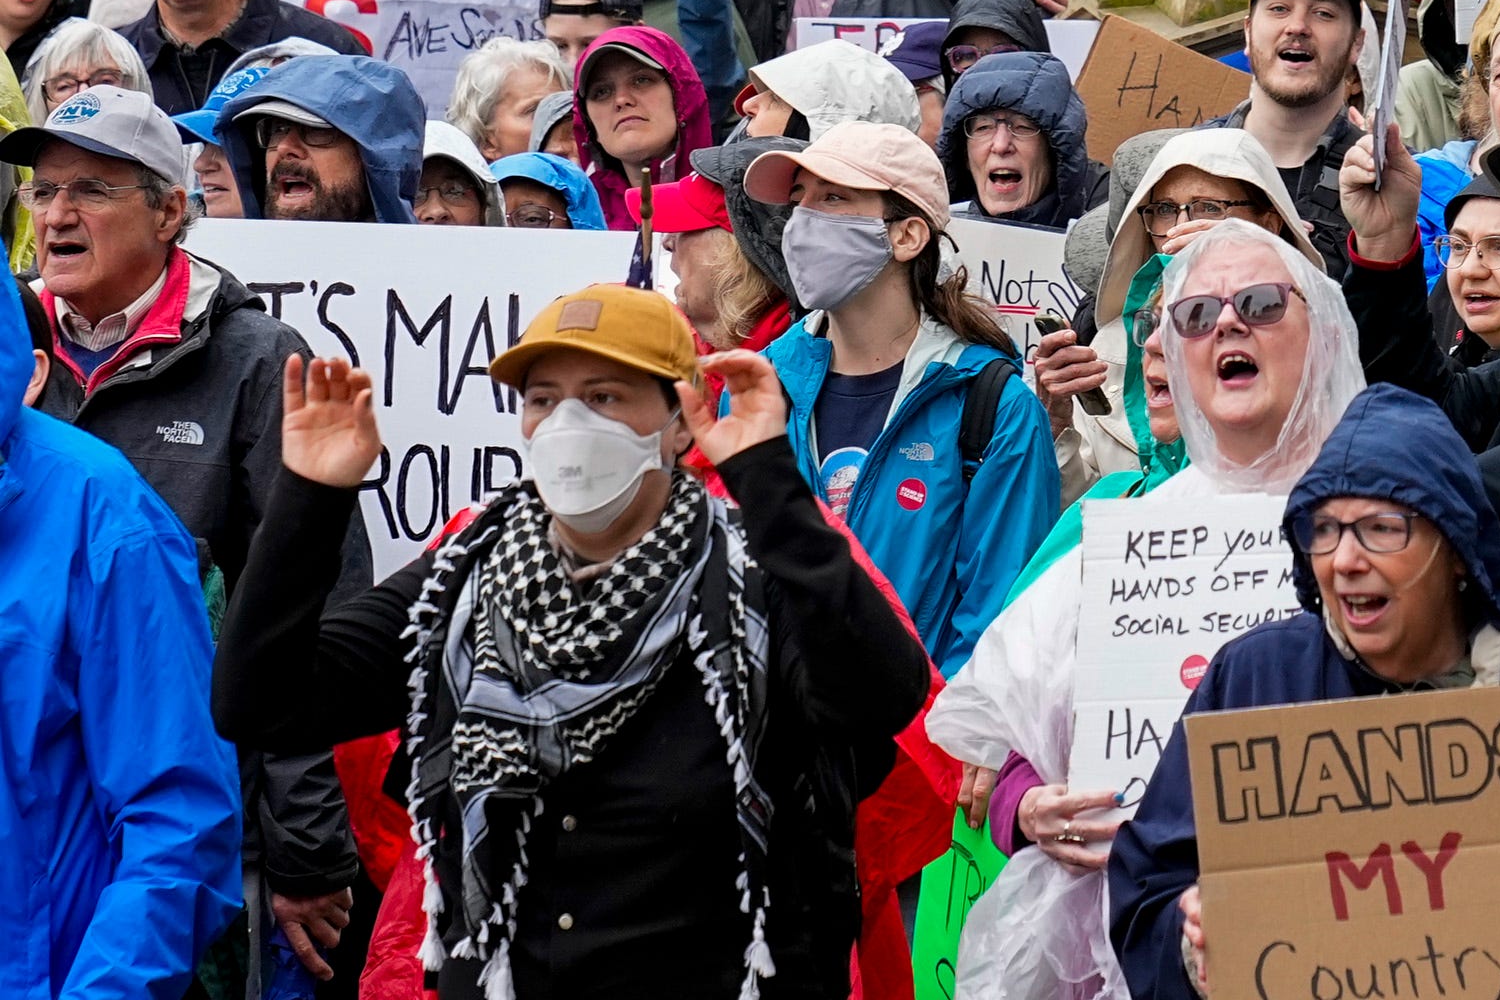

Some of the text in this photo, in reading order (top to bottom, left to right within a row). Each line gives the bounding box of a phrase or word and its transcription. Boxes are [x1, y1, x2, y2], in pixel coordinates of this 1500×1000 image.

[979, 257, 1050, 309] Not
[155, 425, 190, 437] NORTH
[163, 435, 189, 443] FACE
[173, 421, 191, 429] THE
[1124, 525, 1209, 569] KEEP
[1109, 568, 1270, 605] HANDS OFF
[1325, 830, 1463, 922] MY
